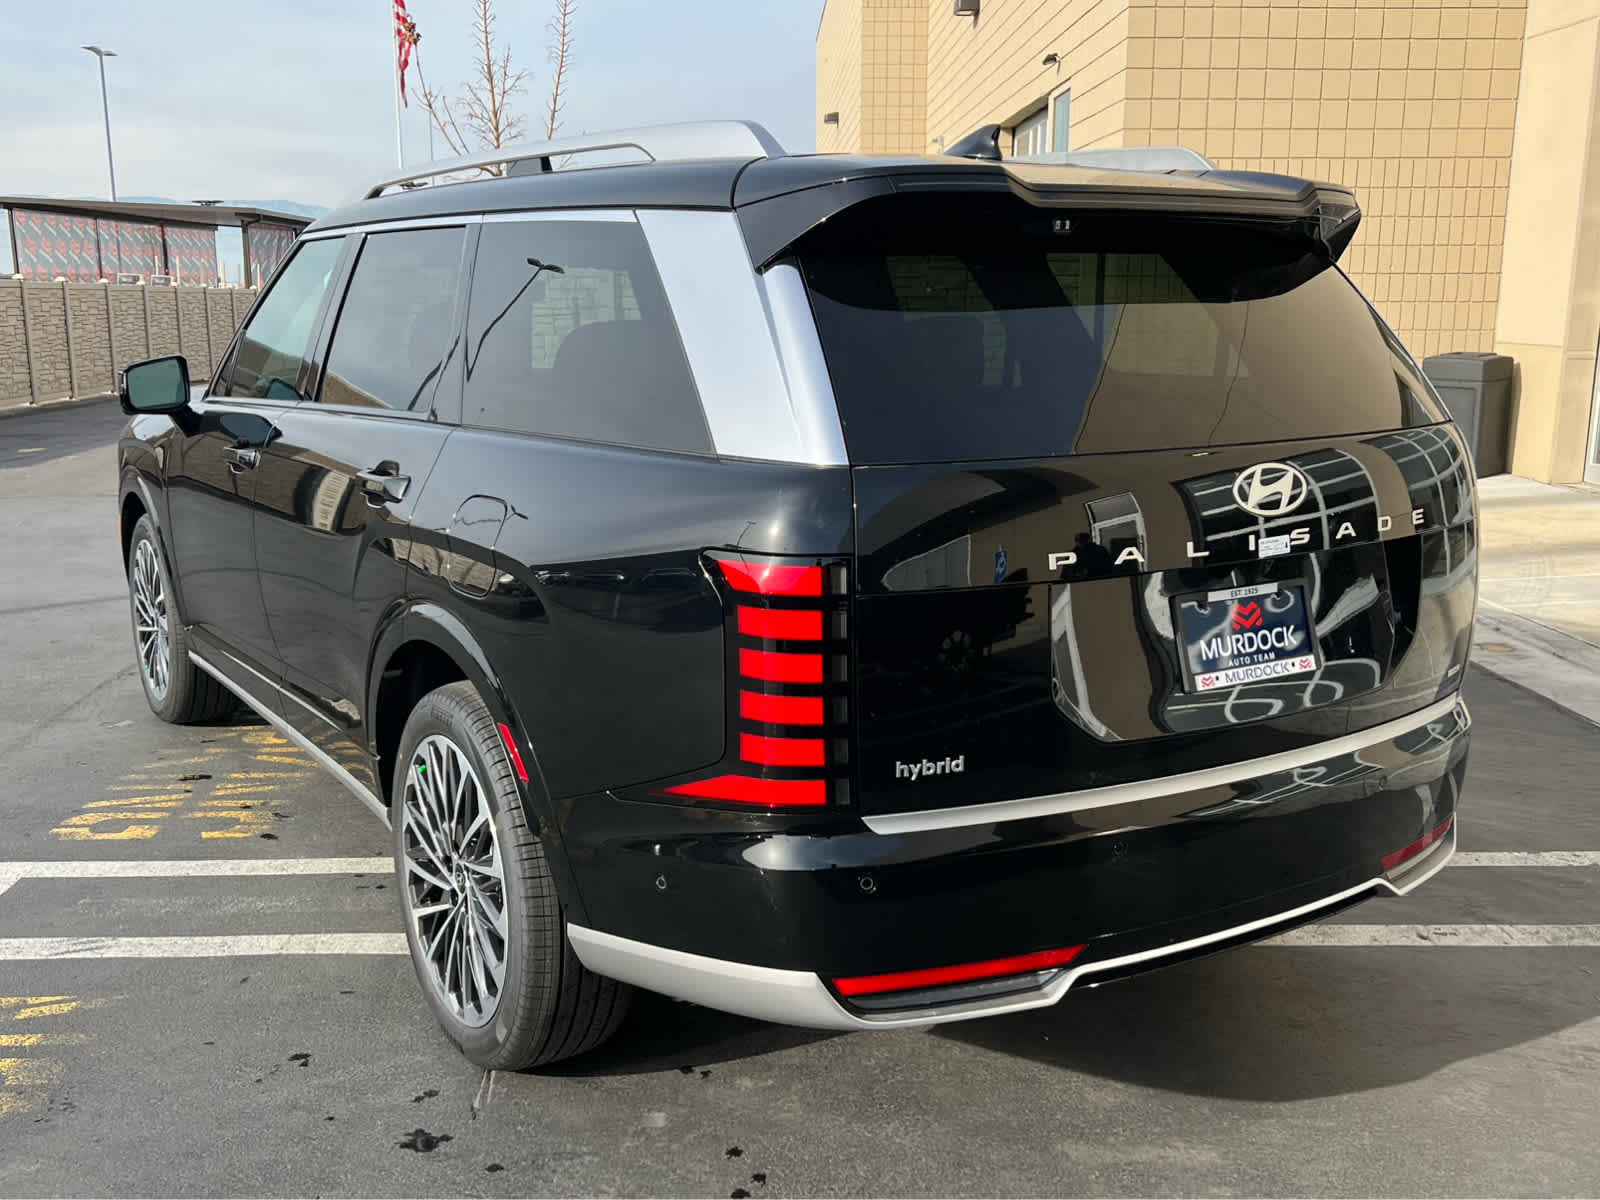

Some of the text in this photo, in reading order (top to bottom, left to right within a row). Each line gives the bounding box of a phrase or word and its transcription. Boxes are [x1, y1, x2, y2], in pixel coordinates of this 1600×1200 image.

[1049, 509, 1425, 571] PALISADE
[1200, 625, 1297, 661] MURDOCK
[1224, 661, 1290, 683] MURDOCK
[1229, 651, 1276, 667] AUTO TEAM
[895, 755, 965, 781] hybrid
